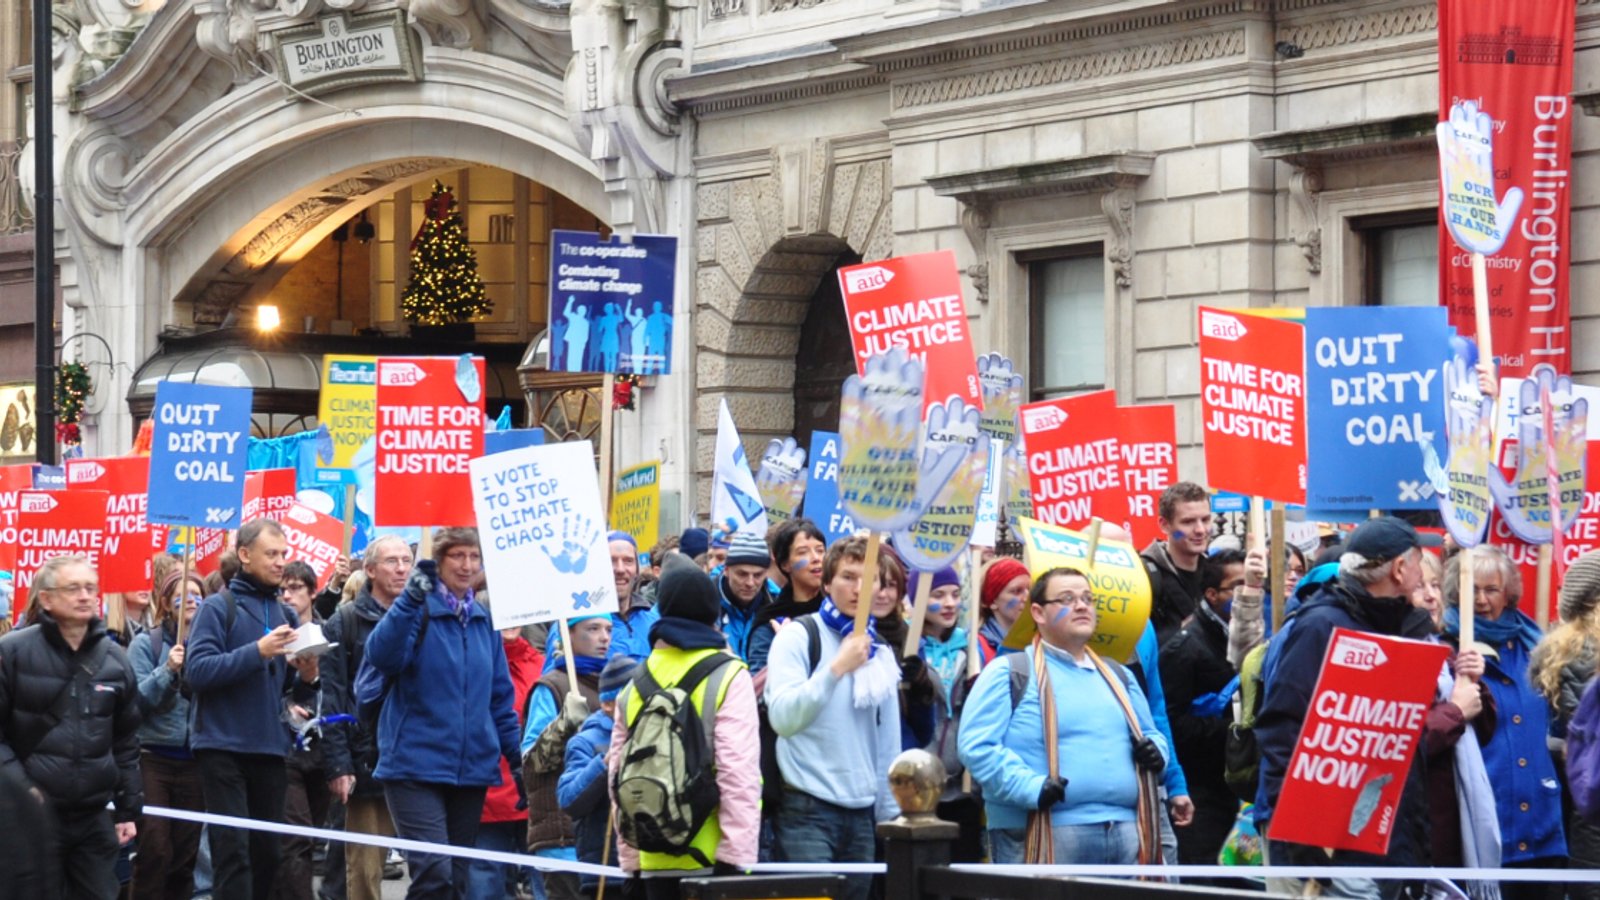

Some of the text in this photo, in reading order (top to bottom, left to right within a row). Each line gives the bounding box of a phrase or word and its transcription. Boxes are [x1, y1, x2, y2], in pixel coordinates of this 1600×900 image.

[295, 33, 384, 65] BURLINGTON
[324, 55, 361, 71] ARCADE
[1464, 181, 1493, 198] OUR
[1448, 193, 1494, 209] CLIMATE
[1521, 95, 1567, 312] Burlington
[1451, 213, 1501, 241] HANDS
[1470, 207, 1496, 226] OUR
[560, 243, 647, 258] The co-operative
[558, 264, 620, 280] Combating
[857, 270, 887, 290] aid
[558, 279, 643, 295] climate change
[853, 294, 962, 334] CLIMATE
[858, 320, 963, 358] JUSTICE
[1212, 320, 1240, 337] aid
[1315, 333, 1403, 368] QUIT
[390, 367, 417, 384] aid
[1203, 357, 1301, 398] TIME FOR
[1331, 368, 1437, 406] DIRTY
[160, 402, 221, 425] QUIT
[1204, 384, 1294, 421] CLIMATE
[379, 405, 481, 426] TIME FOR
[1034, 411, 1061, 430] aid
[1206, 410, 1293, 446] JUSTICE
[1345, 412, 1436, 446] COAL
[168, 429, 241, 454] DIRTY
[379, 429, 472, 450] CLIMATE
[378, 453, 470, 474] JUSTICE
[1030, 438, 1119, 475] CLIMATE
[77, 465, 98, 480] aid
[174, 460, 234, 482] COAL
[481, 462, 542, 491] I VOTE
[1034, 464, 1120, 501] JUSTICE
[28, 497, 50, 512] aid
[267, 496, 294, 509] FOR
[484, 478, 559, 510] TO STOP
[844, 489, 923, 510] HANDS
[1504, 488, 1582, 510] JUSTCE
[490, 498, 572, 531] CLIMATE
[1038, 496, 1092, 525] NOW
[19, 528, 103, 548] CLIMATE
[495, 522, 555, 551] CHAOS
[908, 521, 972, 537] USTICE
[913, 535, 956, 553] NOW
[1343, 647, 1378, 668] aid
[1315, 689, 1426, 730] CLIMATE
[1303, 723, 1413, 761] JUSTICE
[1292, 751, 1368, 790] NOW
